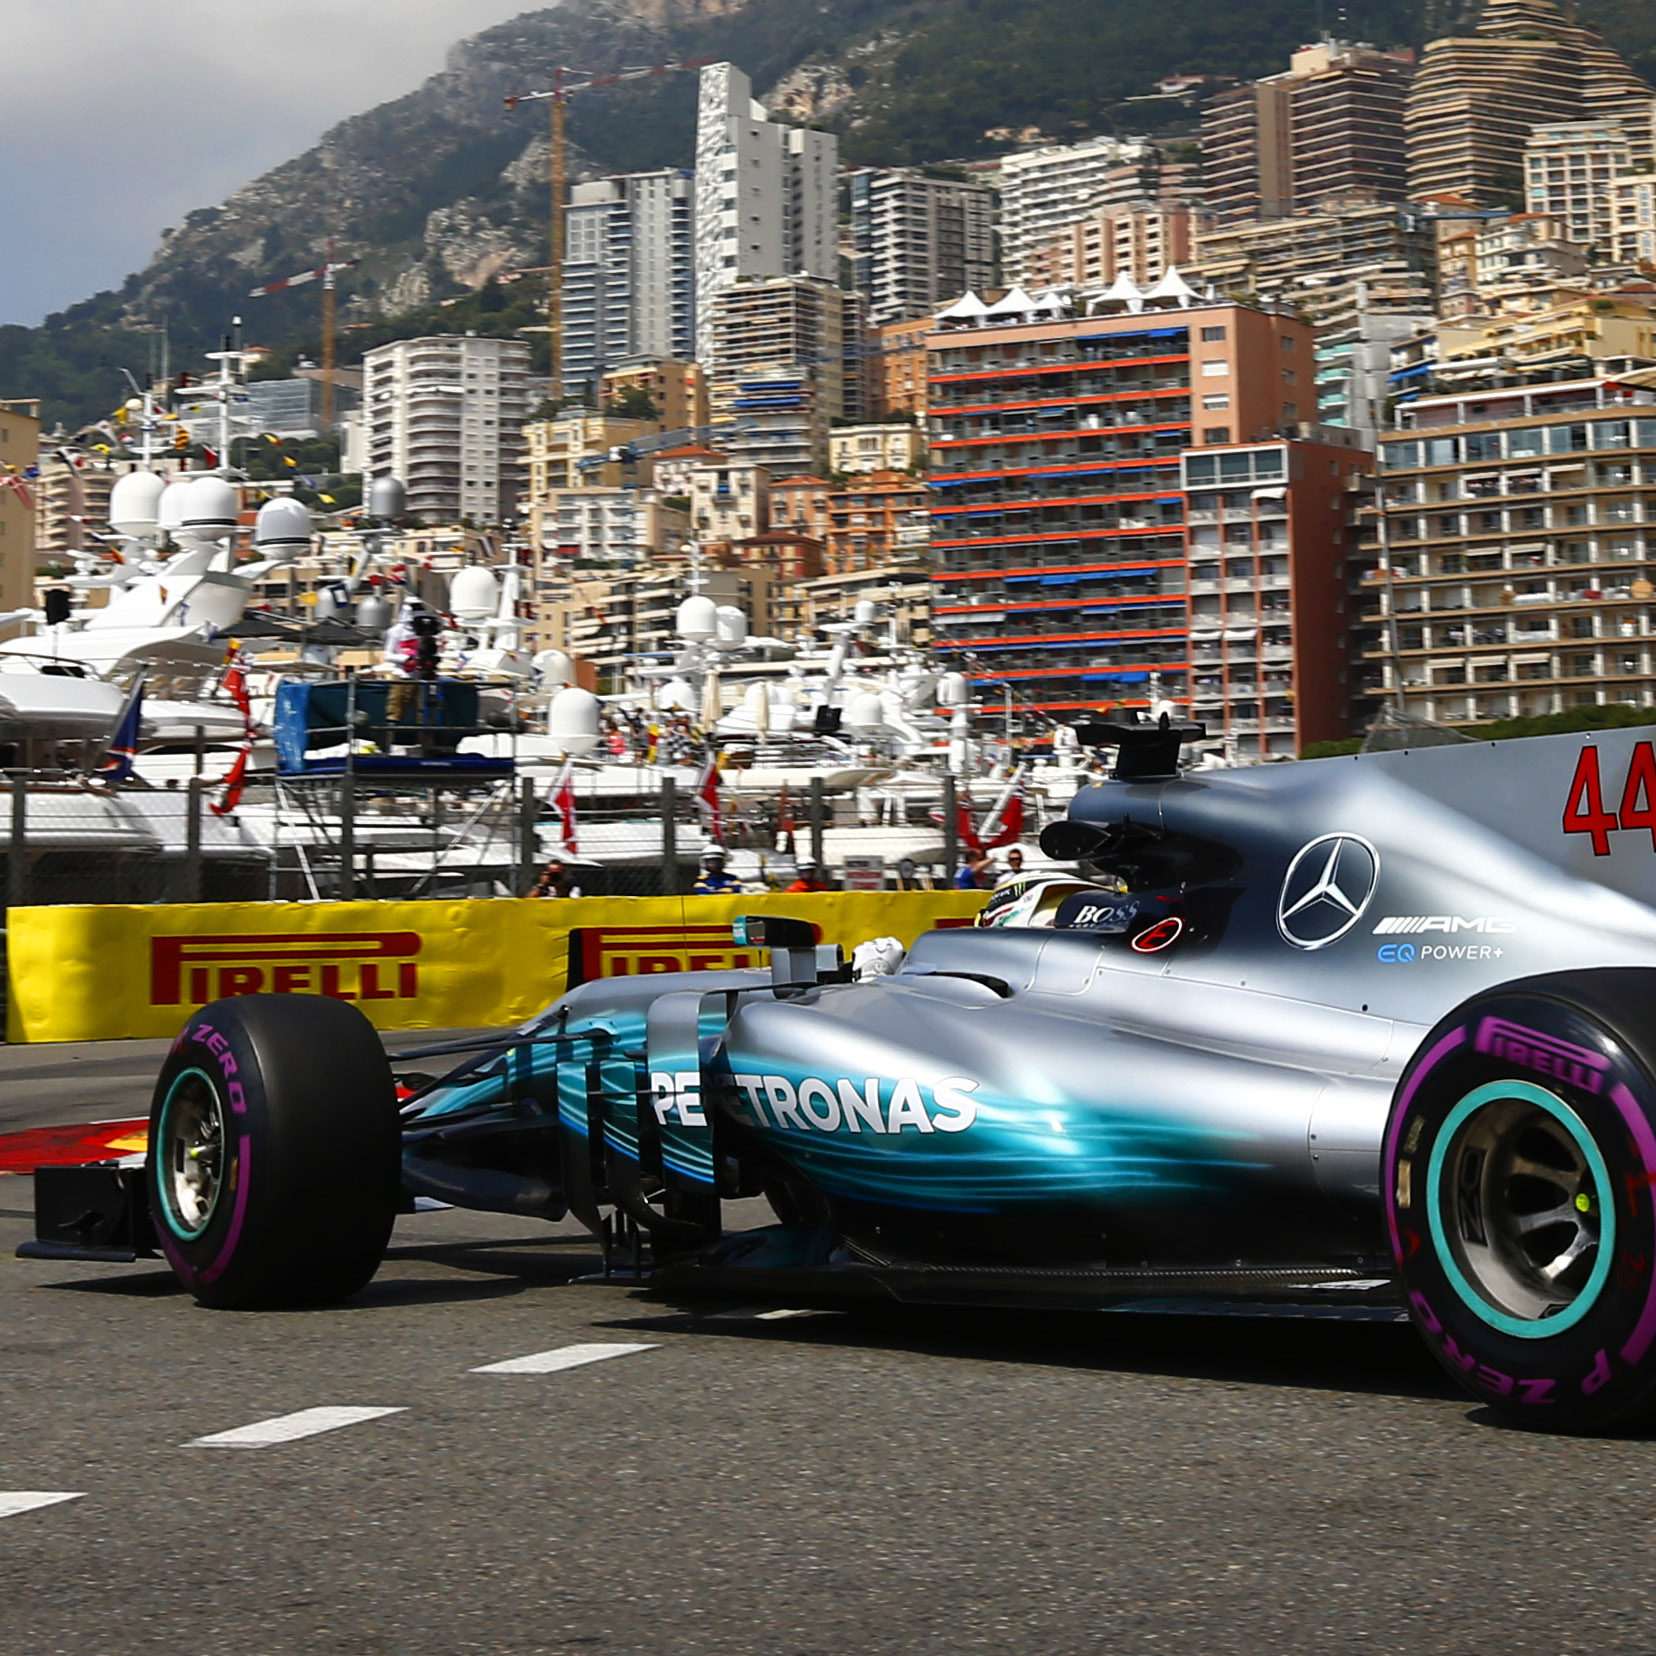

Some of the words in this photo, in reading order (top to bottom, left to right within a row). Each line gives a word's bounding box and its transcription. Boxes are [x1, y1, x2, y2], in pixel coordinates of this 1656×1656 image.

[1072, 900, 1141, 925] BOSS
[1414, 915, 1518, 934] AMG
[151, 931, 423, 1006] PIRELLI
[1377, 943, 1416, 964] EQ
[191, 1023, 248, 1115] ZERO
[1474, 1015, 1612, 1095] PIRELLI
[1408, 1289, 1557, 1405] ZERO
[1580, 1348, 1612, 1395] P
